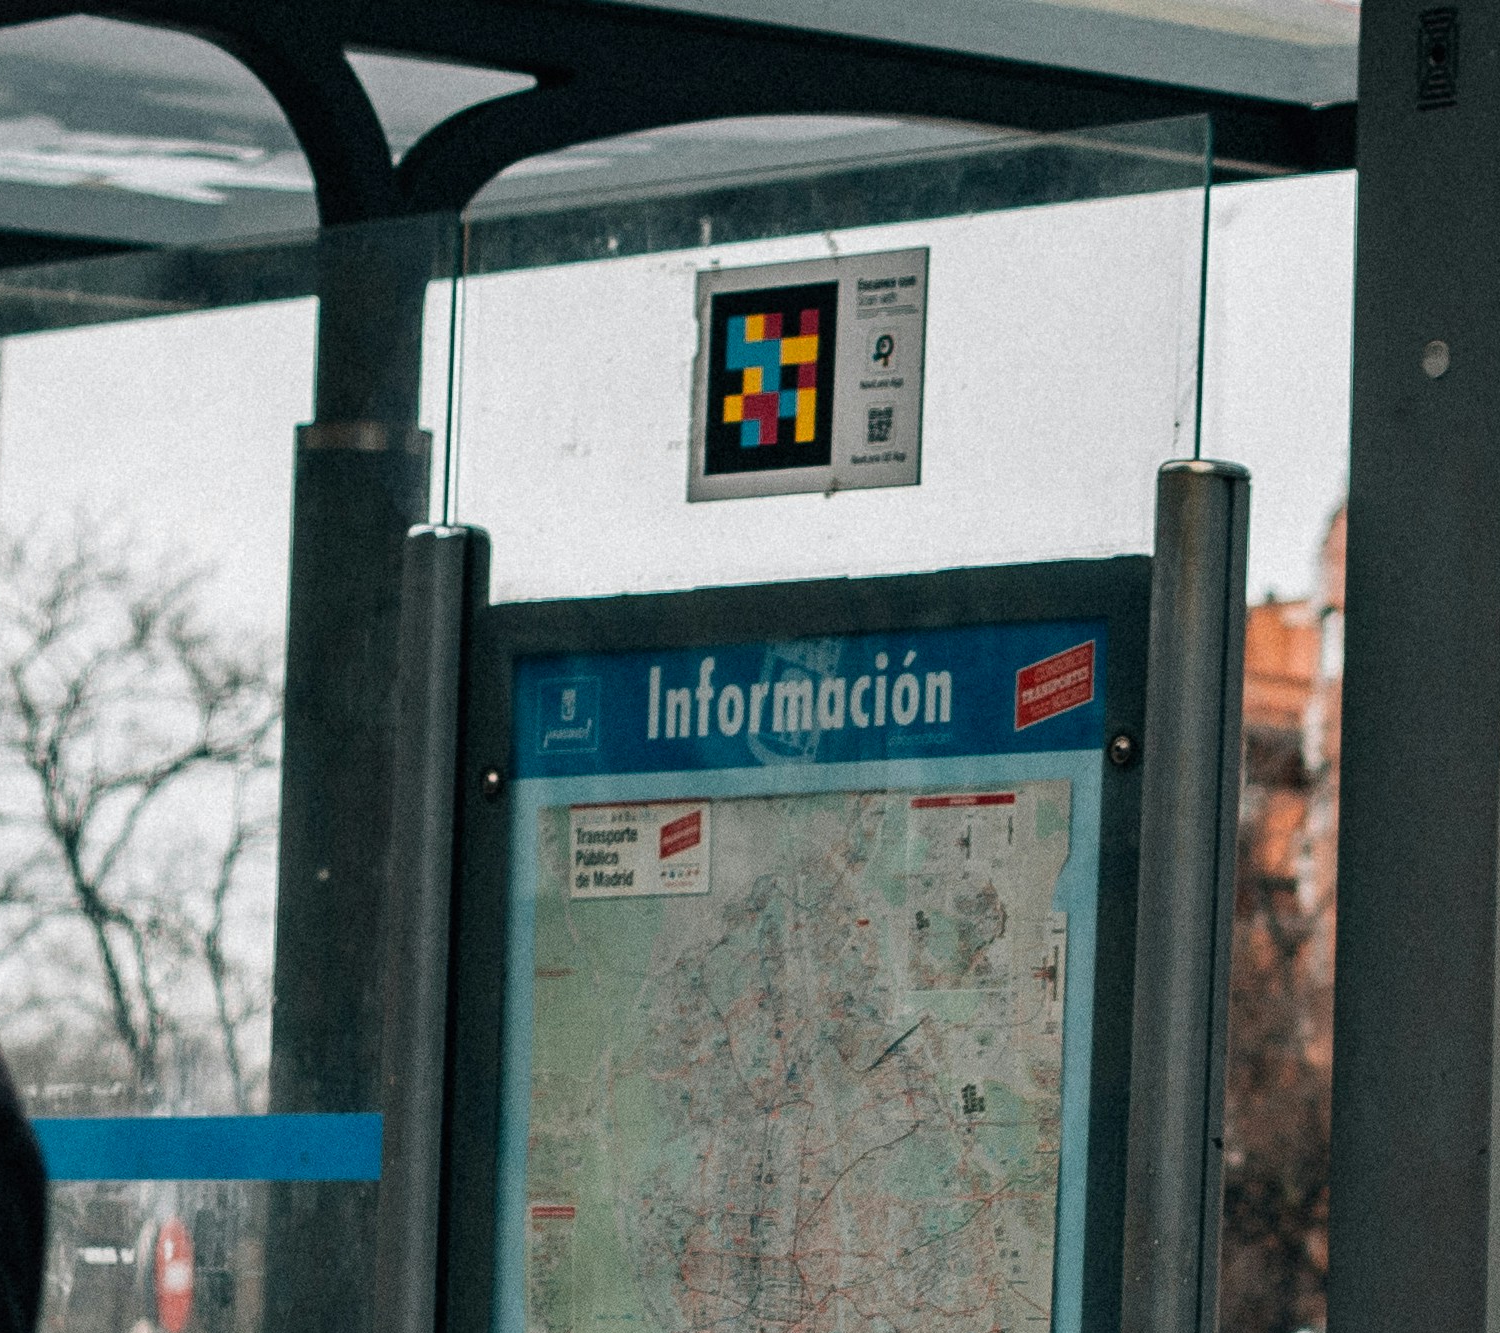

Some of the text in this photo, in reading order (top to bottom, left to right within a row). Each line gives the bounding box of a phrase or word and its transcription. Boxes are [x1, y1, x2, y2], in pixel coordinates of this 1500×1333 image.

[648, 651, 953, 740] Información
[575, 826, 639, 846] Transporte
[575, 848, 619, 867] Público
[575, 869, 634, 888] de Madrid
